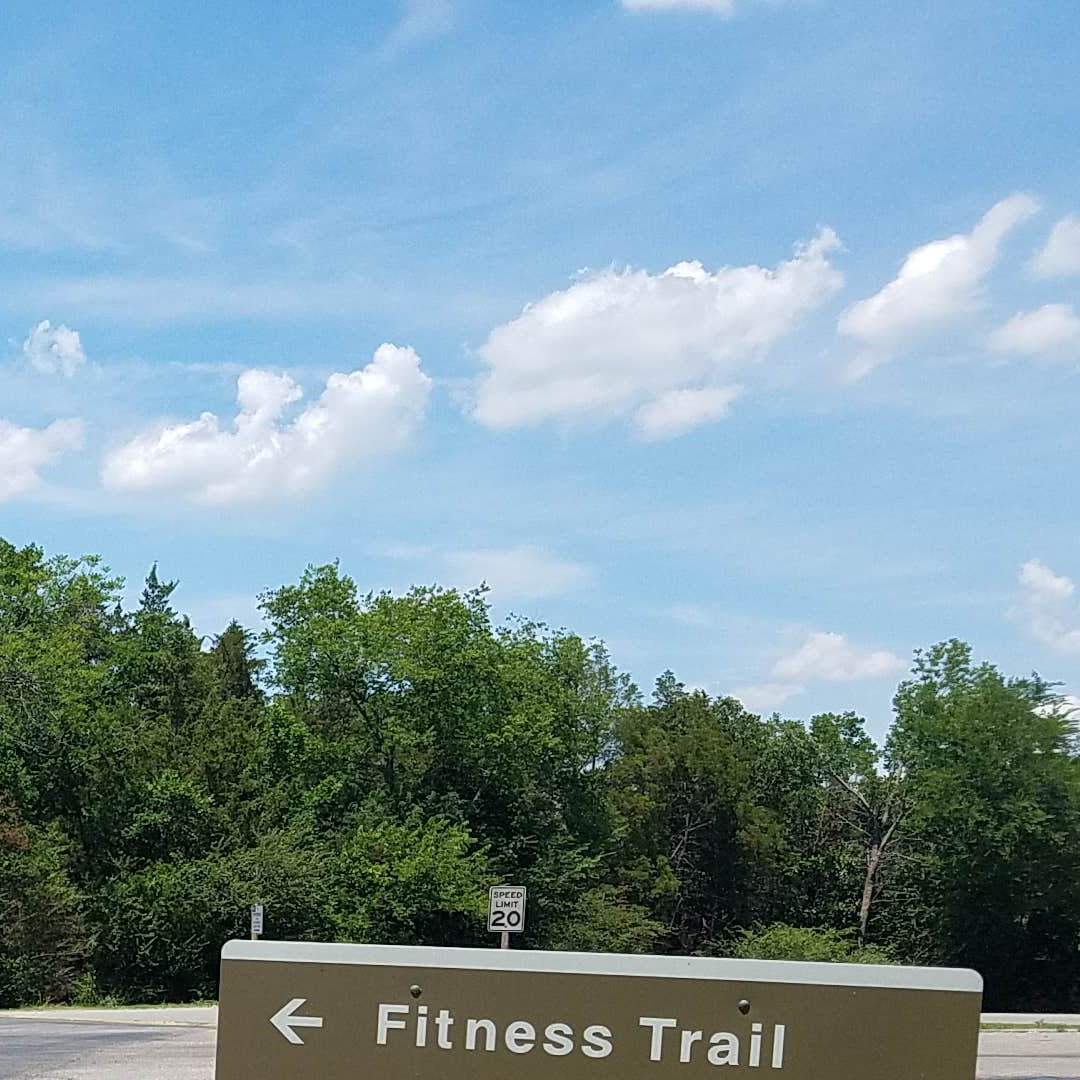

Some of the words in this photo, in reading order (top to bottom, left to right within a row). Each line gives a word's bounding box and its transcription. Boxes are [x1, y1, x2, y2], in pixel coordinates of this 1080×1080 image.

[491, 911, 520, 926] 20
[376, 1003, 613, 1058] Fitness
[639, 1016, 786, 1069] Trail
